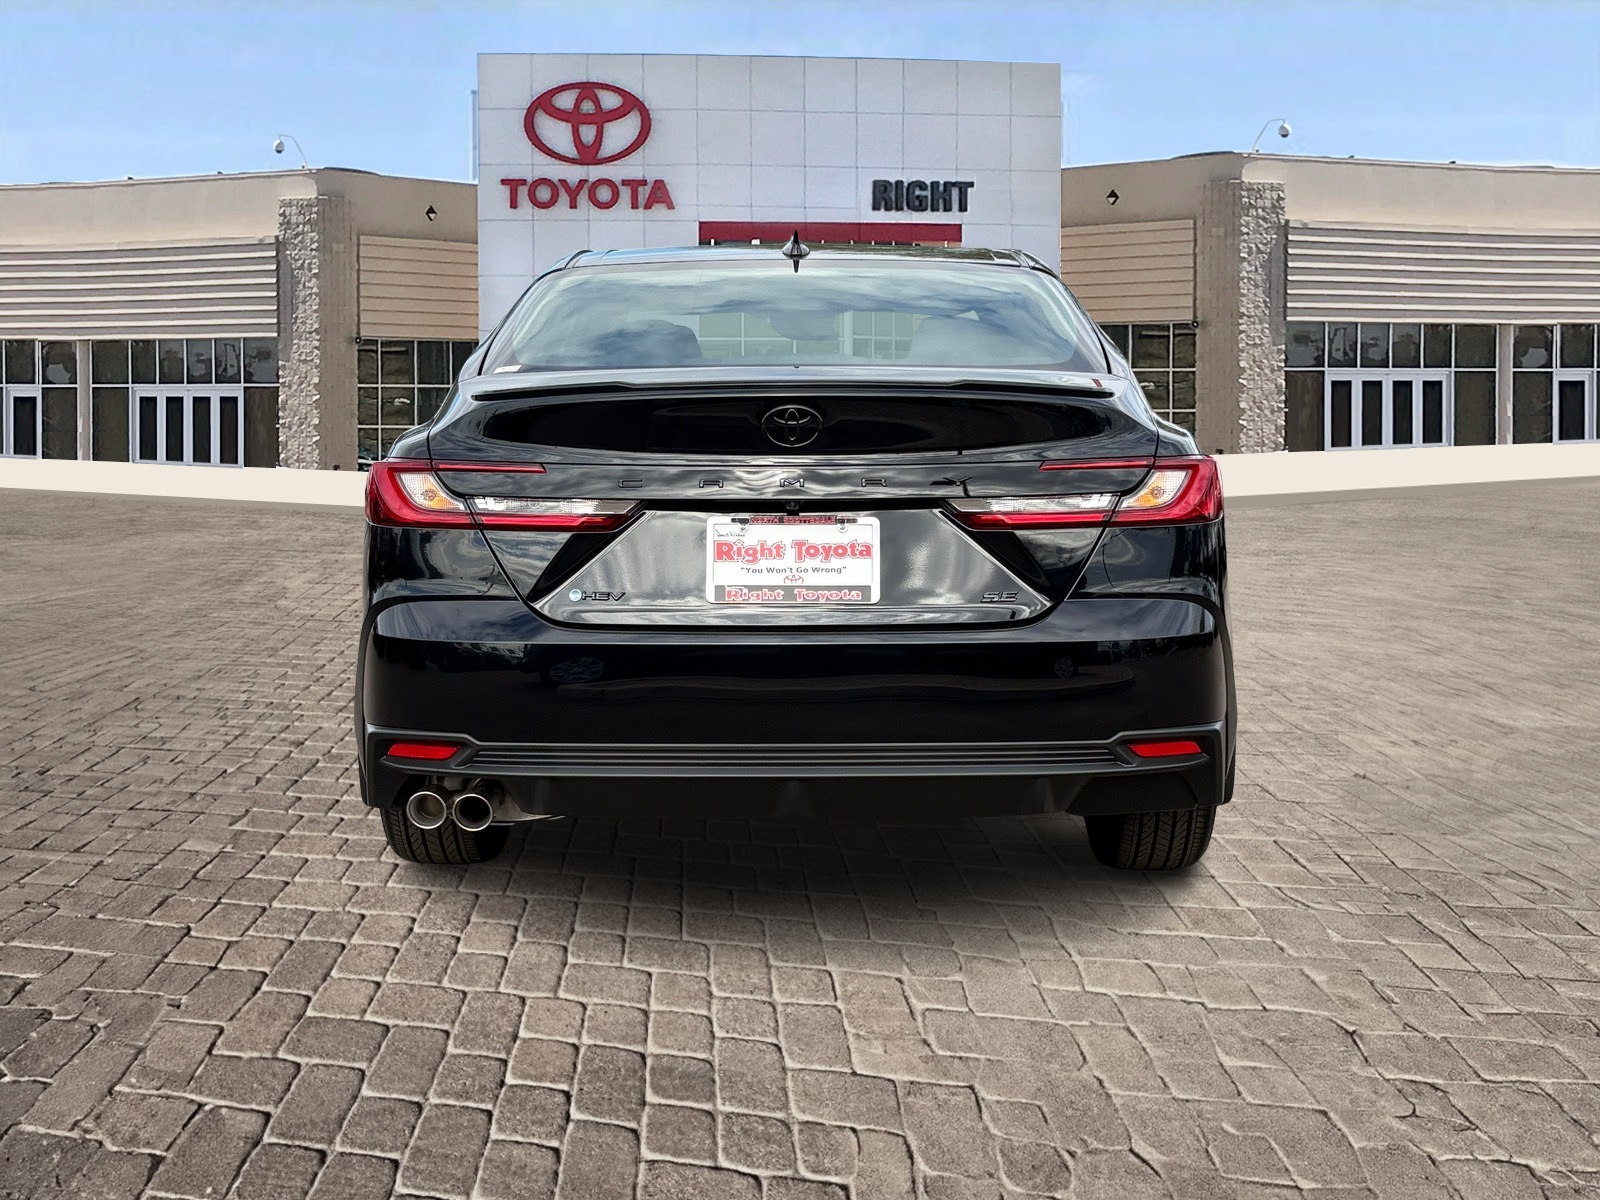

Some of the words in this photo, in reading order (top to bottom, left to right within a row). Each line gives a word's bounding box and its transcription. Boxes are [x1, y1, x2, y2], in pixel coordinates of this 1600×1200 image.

[500, 177, 675, 210] TOYOTA
[871, 179, 975, 212] RIGHT
[618, 476, 972, 489] CAMRY
[714, 539, 785, 564] Right
[791, 539, 873, 563] Toyota
[740, 566, 763, 574] "You
[766, 566, 793, 574] Won't
[796, 566, 809, 574] Go
[811, 566, 847, 575] Wrong"
[581, 591, 626, 602] HEV
[725, 588, 785, 602] Right
[794, 588, 862, 601] Toyota
[980, 591, 1018, 602] SE
